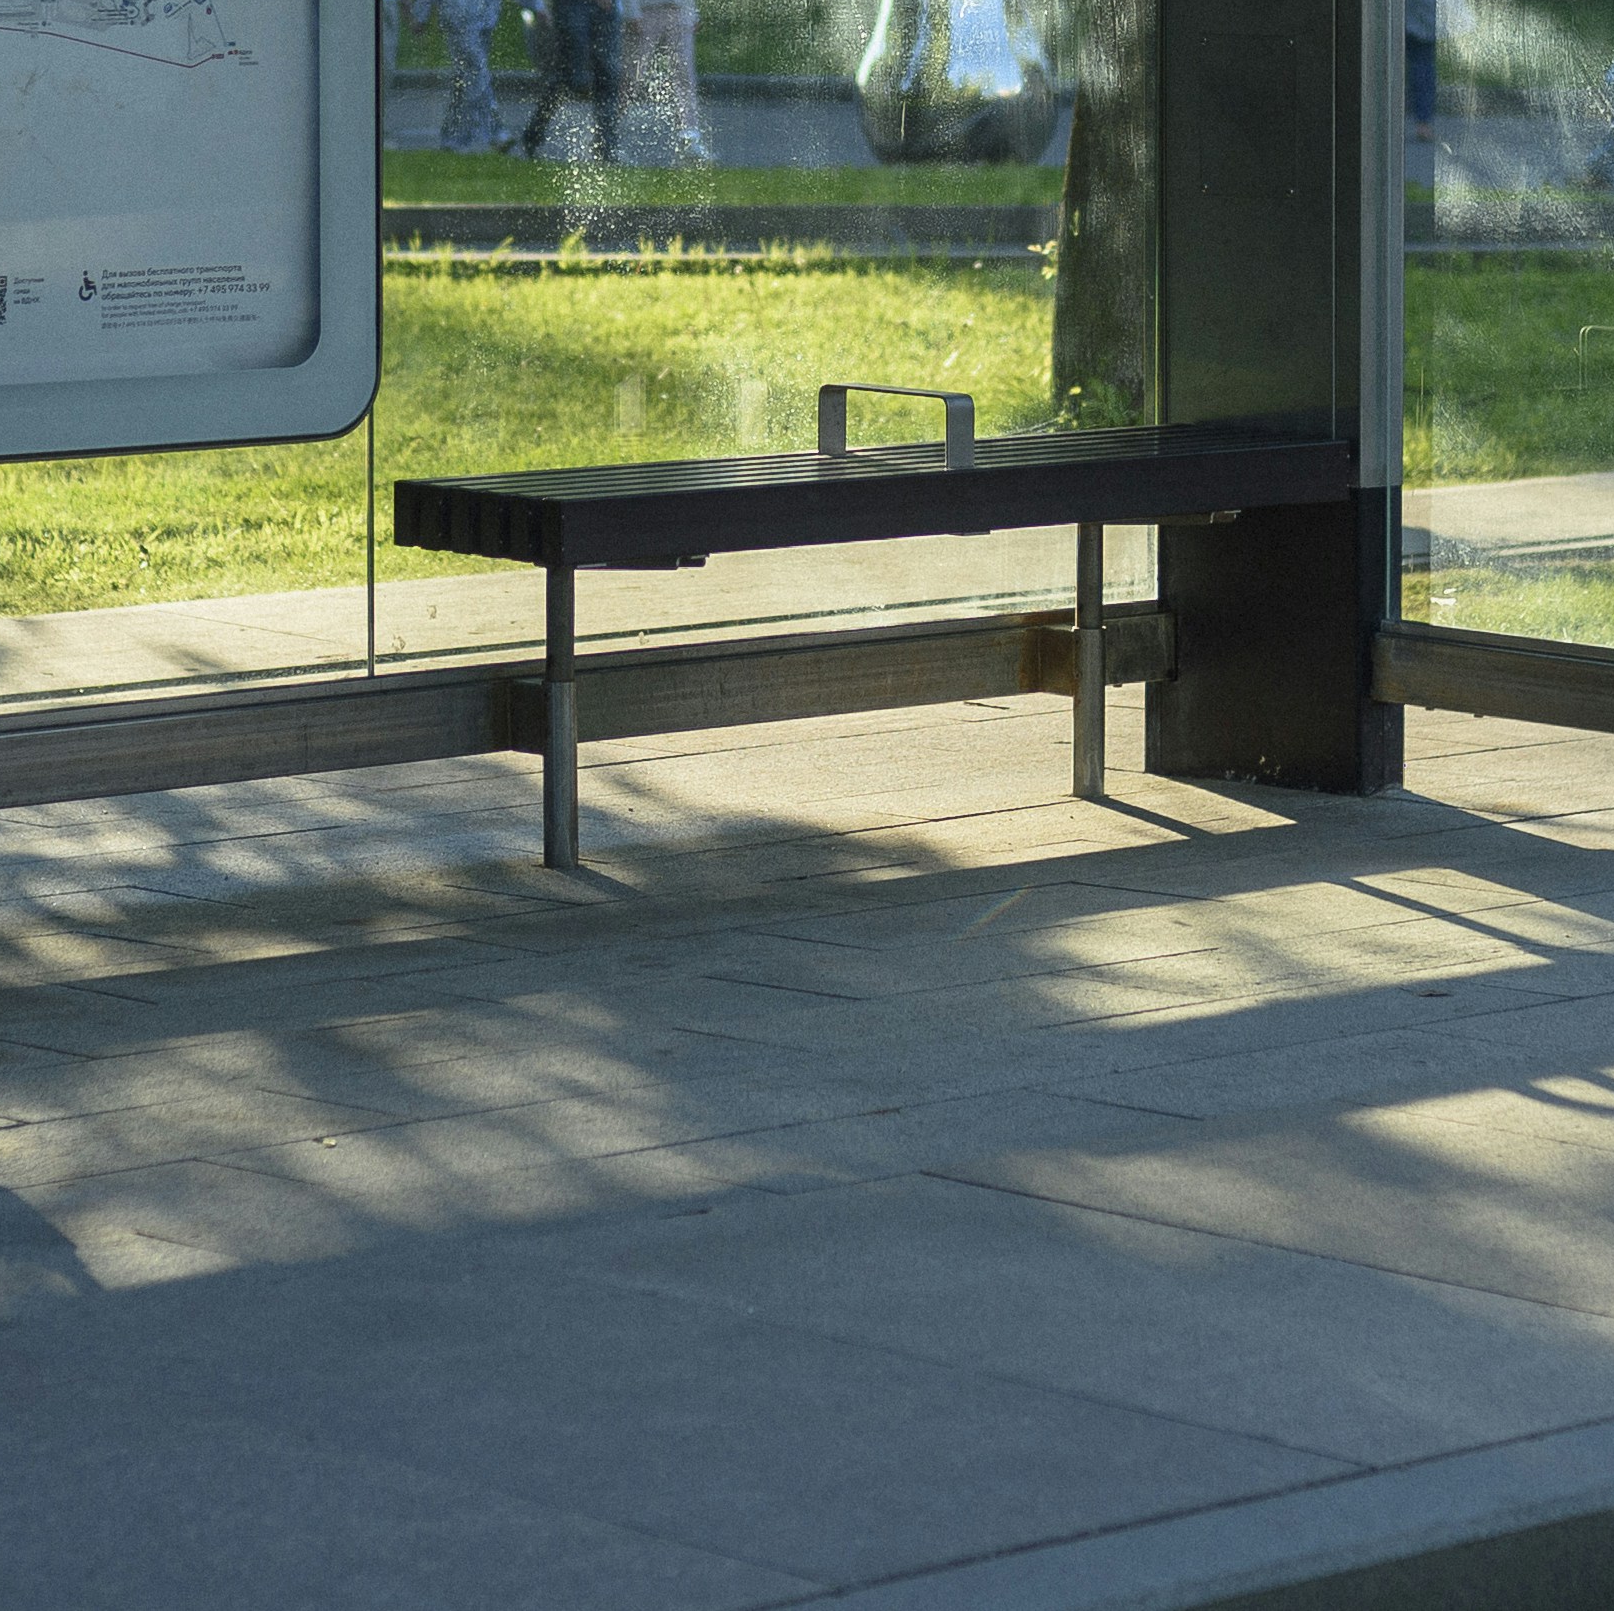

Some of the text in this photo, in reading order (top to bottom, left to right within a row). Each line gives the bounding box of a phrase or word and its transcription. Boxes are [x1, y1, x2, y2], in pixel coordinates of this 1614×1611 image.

[102, 270, 117, 279] Для
[147, 267, 194, 276] бесплатного
[196, 265, 242, 274] транспорта
[117, 279, 177, 288] маломобильных
[179, 278, 201, 286] групп
[203, 276, 245, 287] населения
[102, 292, 152, 301] обращайтесь
[164, 289, 194, 297] номеру:
[210, 285, 226, 293] 495
[228, 284, 244, 292] 974
[247, 283, 257, 293] 33
[259, 283, 270, 291] 99
